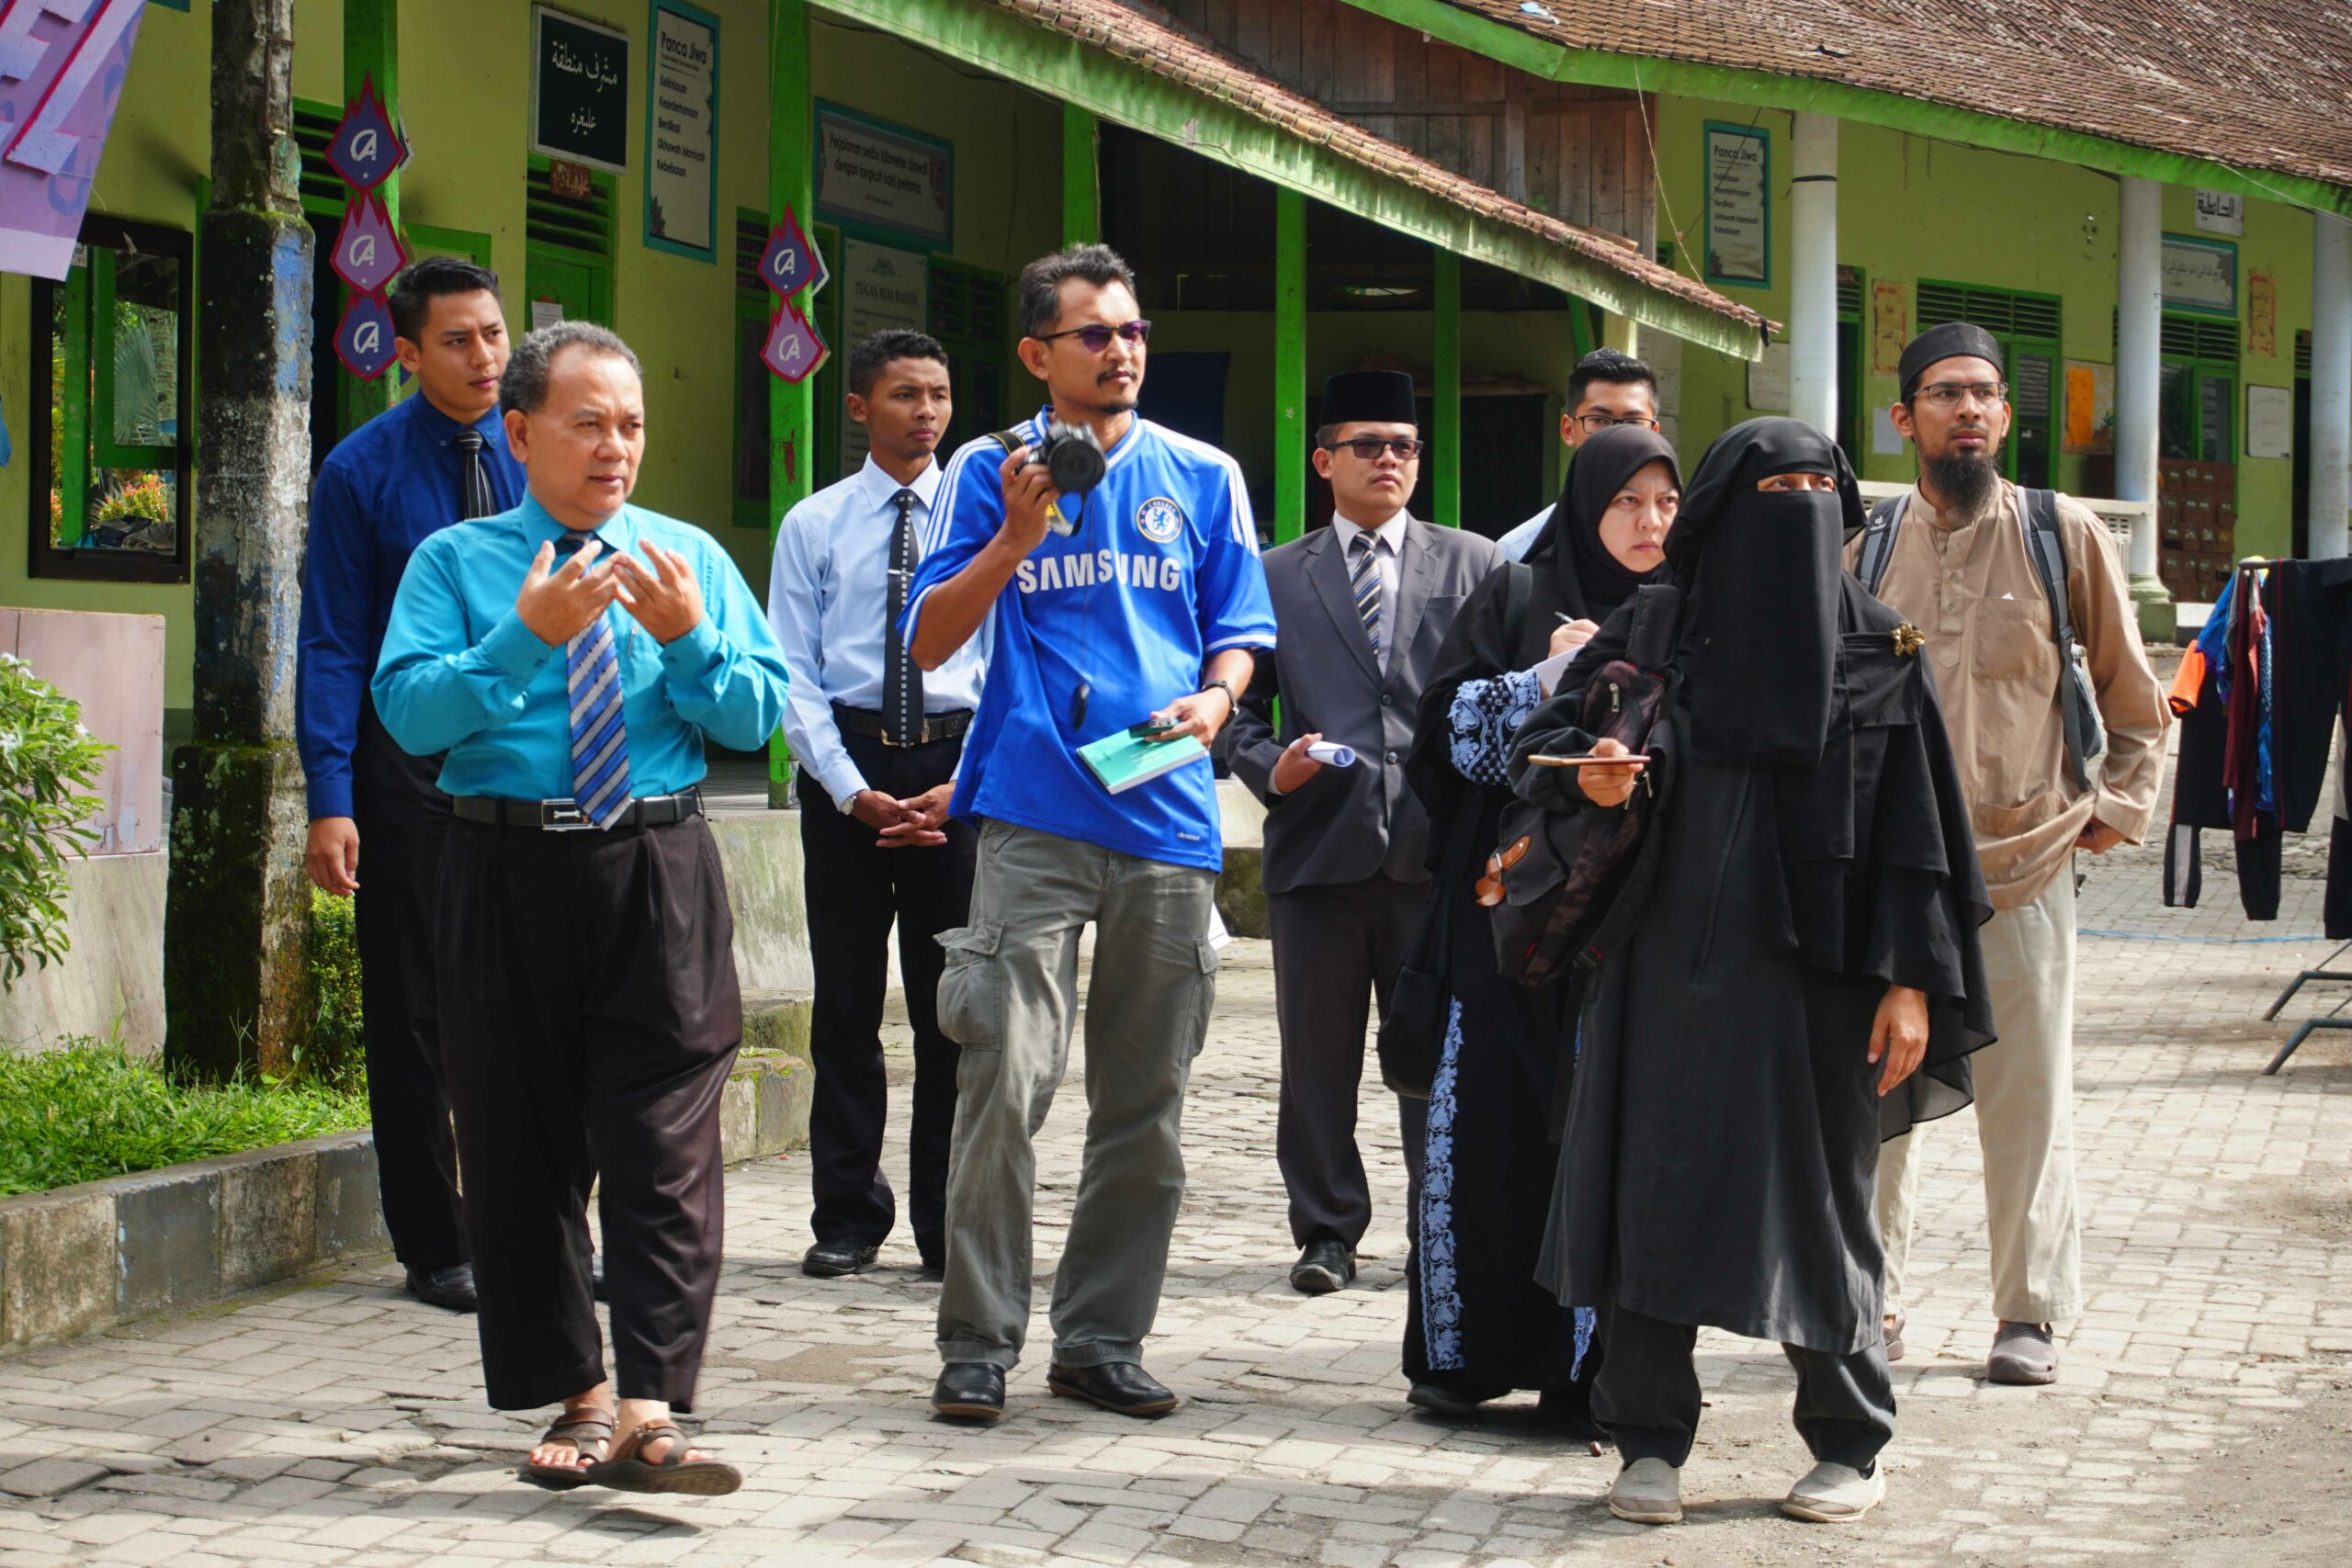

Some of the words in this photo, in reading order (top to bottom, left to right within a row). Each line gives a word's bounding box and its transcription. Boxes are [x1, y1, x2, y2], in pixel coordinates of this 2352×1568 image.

[552, 40, 583, 74] منطقة
[662, 30, 687, 57] Panca
[689, 42, 707, 64] Jiwa
[585, 52, 618, 93] مشرف
[658, 116, 682, 134] Berdikari
[656, 158, 687, 177] Kebebasan
[1713, 145, 1739, 159] Panca
[1740, 151, 1757, 162] Jiwa
[1015, 548, 1182, 593] SAMSUNG
